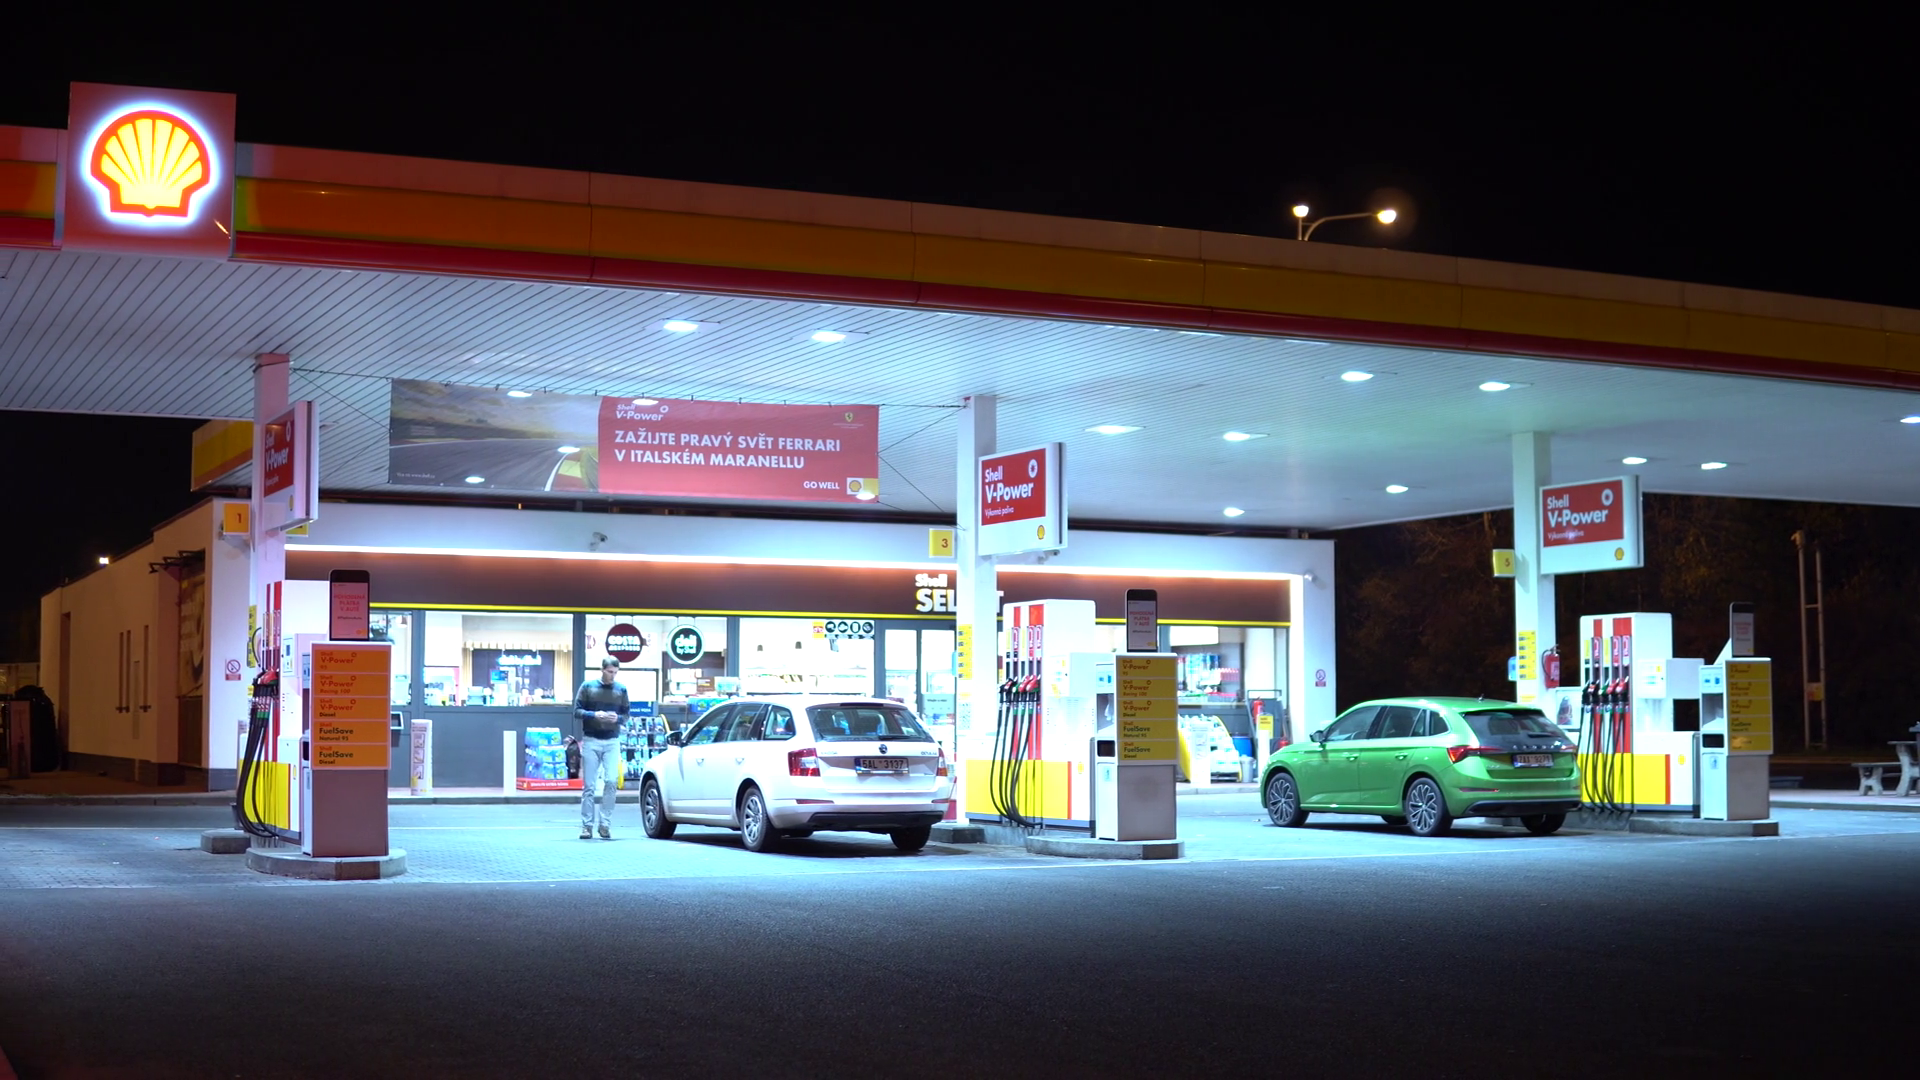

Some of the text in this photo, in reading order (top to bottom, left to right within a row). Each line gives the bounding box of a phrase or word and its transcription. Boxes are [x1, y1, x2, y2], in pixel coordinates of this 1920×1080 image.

[615, 410, 664, 421] V-Power
[614, 427, 841, 452] ZAŽIJTE PRAVÝ SVĚT FERRARI
[266, 447, 289, 473] V-Power
[614, 449, 805, 469] V ITALSKÉM MARANELLU
[985, 465, 1003, 483] Shell
[803, 480, 840, 490] GO WELL
[985, 482, 1034, 504] V-Power
[1547, 494, 1569, 510] Shell
[237, 512, 242, 524] 1
[1547, 509, 1609, 528] V-Power
[941, 538, 949, 549] 3
[1505, 558, 1511, 567] 5
[915, 573, 948, 588] Shell
[608, 635, 641, 646] COSTA
[675, 634, 697, 647] deli
[321, 656, 354, 664] V-Power
[862, 759, 904, 770] 5AL 3137
